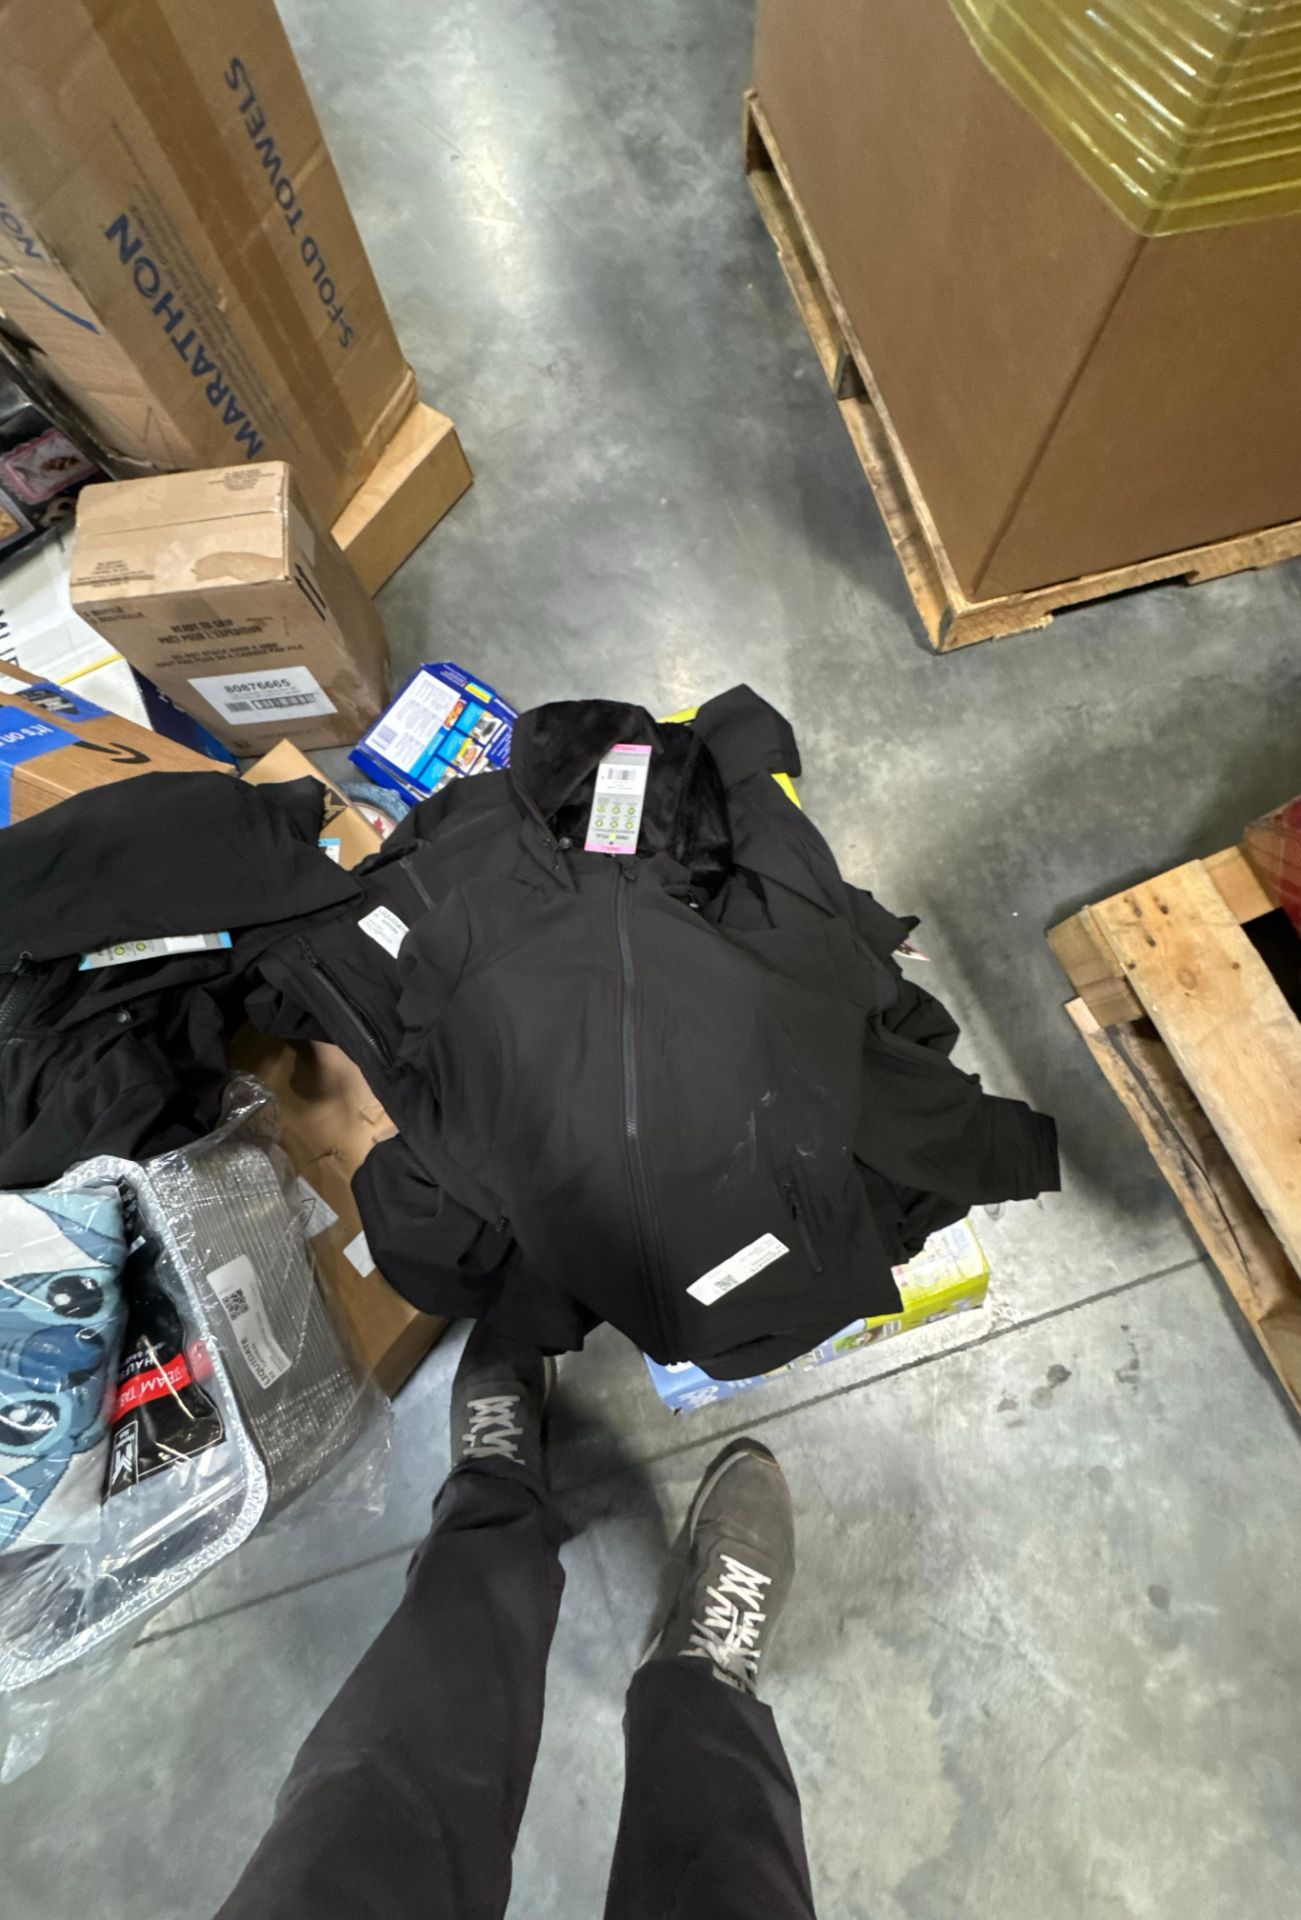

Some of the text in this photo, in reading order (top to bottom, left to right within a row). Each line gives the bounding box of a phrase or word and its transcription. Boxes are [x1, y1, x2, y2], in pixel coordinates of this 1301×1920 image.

[224, 57, 354, 348] S-FOLD TOWELS
[104, 213, 264, 459] MARATHON
[224, 679, 291, 694] 80876665
[241, 1337, 271, 1387] LIQUIDATE
